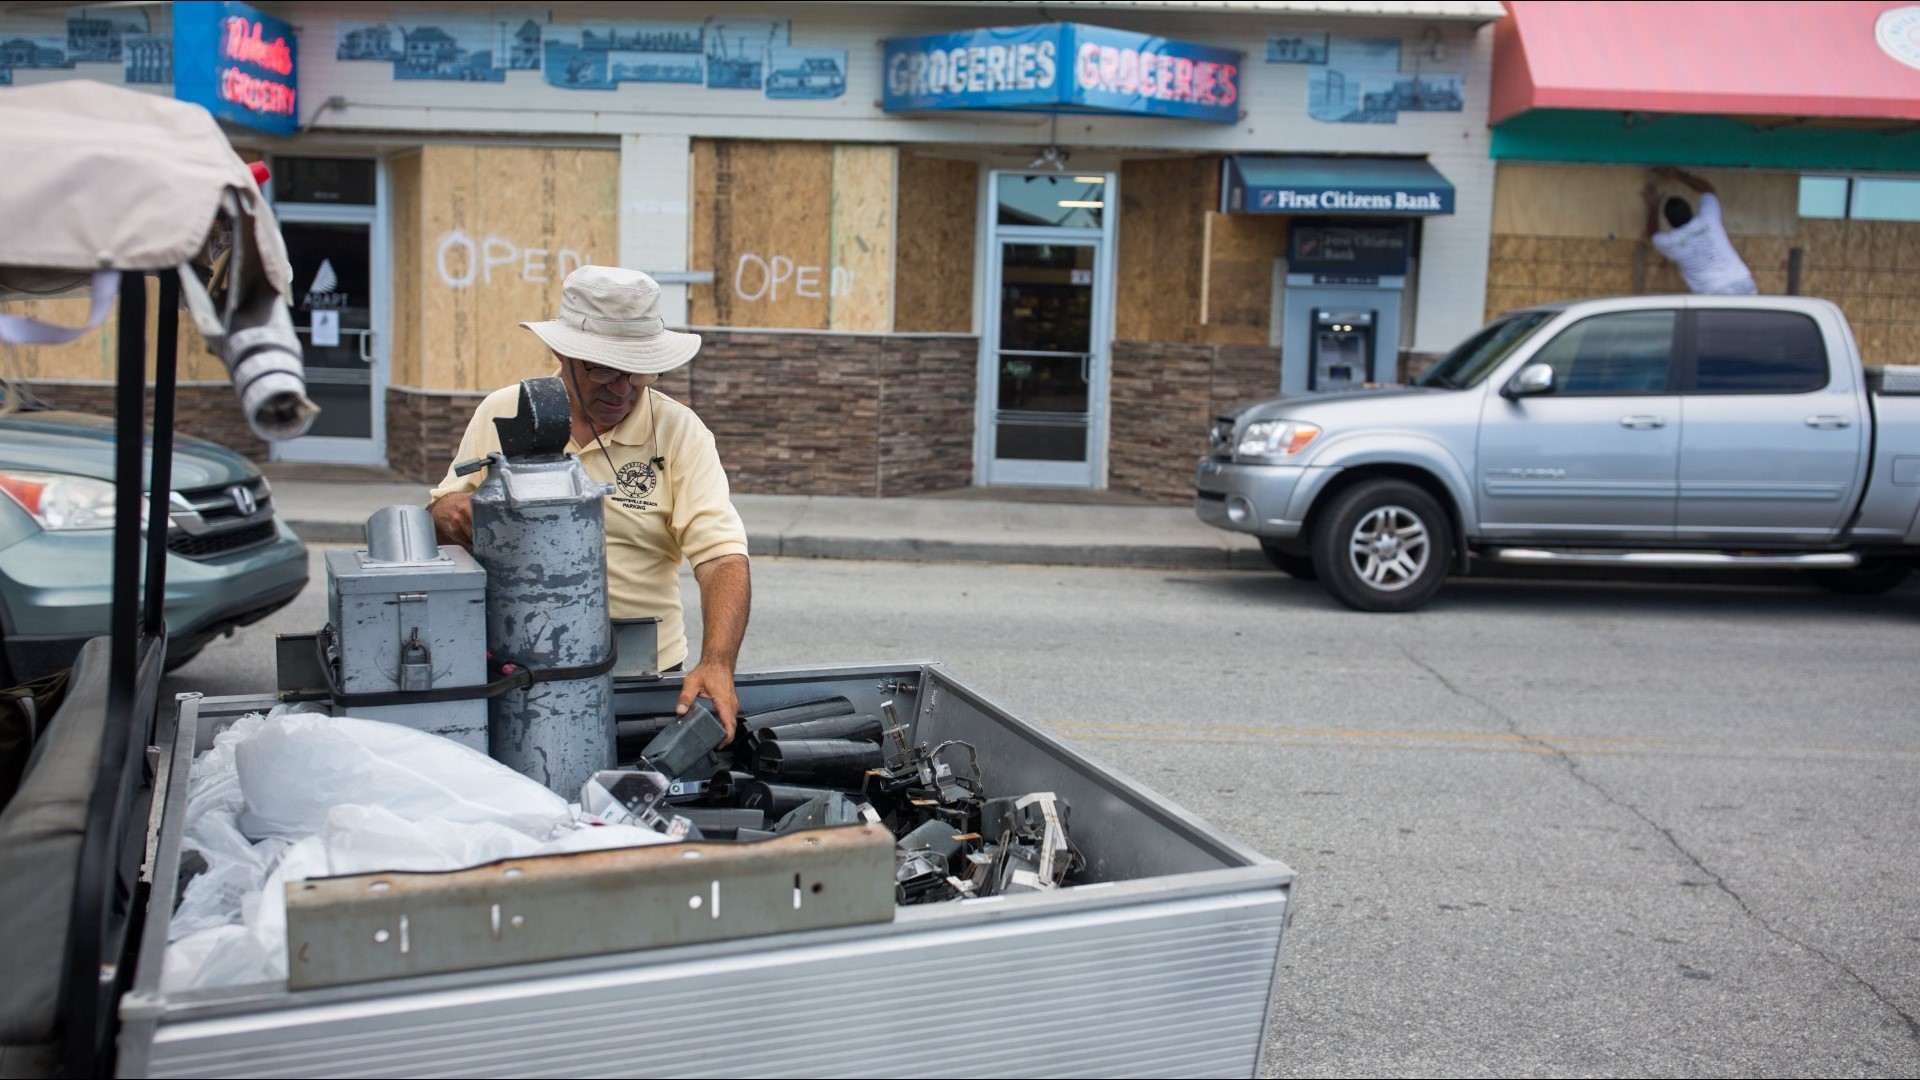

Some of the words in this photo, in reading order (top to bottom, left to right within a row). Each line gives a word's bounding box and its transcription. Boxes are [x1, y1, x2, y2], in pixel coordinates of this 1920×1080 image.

[222, 66, 296, 115] GROCERY
[887, 40, 1057, 96] GROCERIES
[1076, 42, 1239, 107] GROCERIES
[1278, 190, 1318, 209] First
[1320, 190, 1392, 210] Citizens
[1394, 191, 1441, 210] Bank
[303, 292, 349, 309] ADAPT
[735, 253, 856, 302] OPEN
